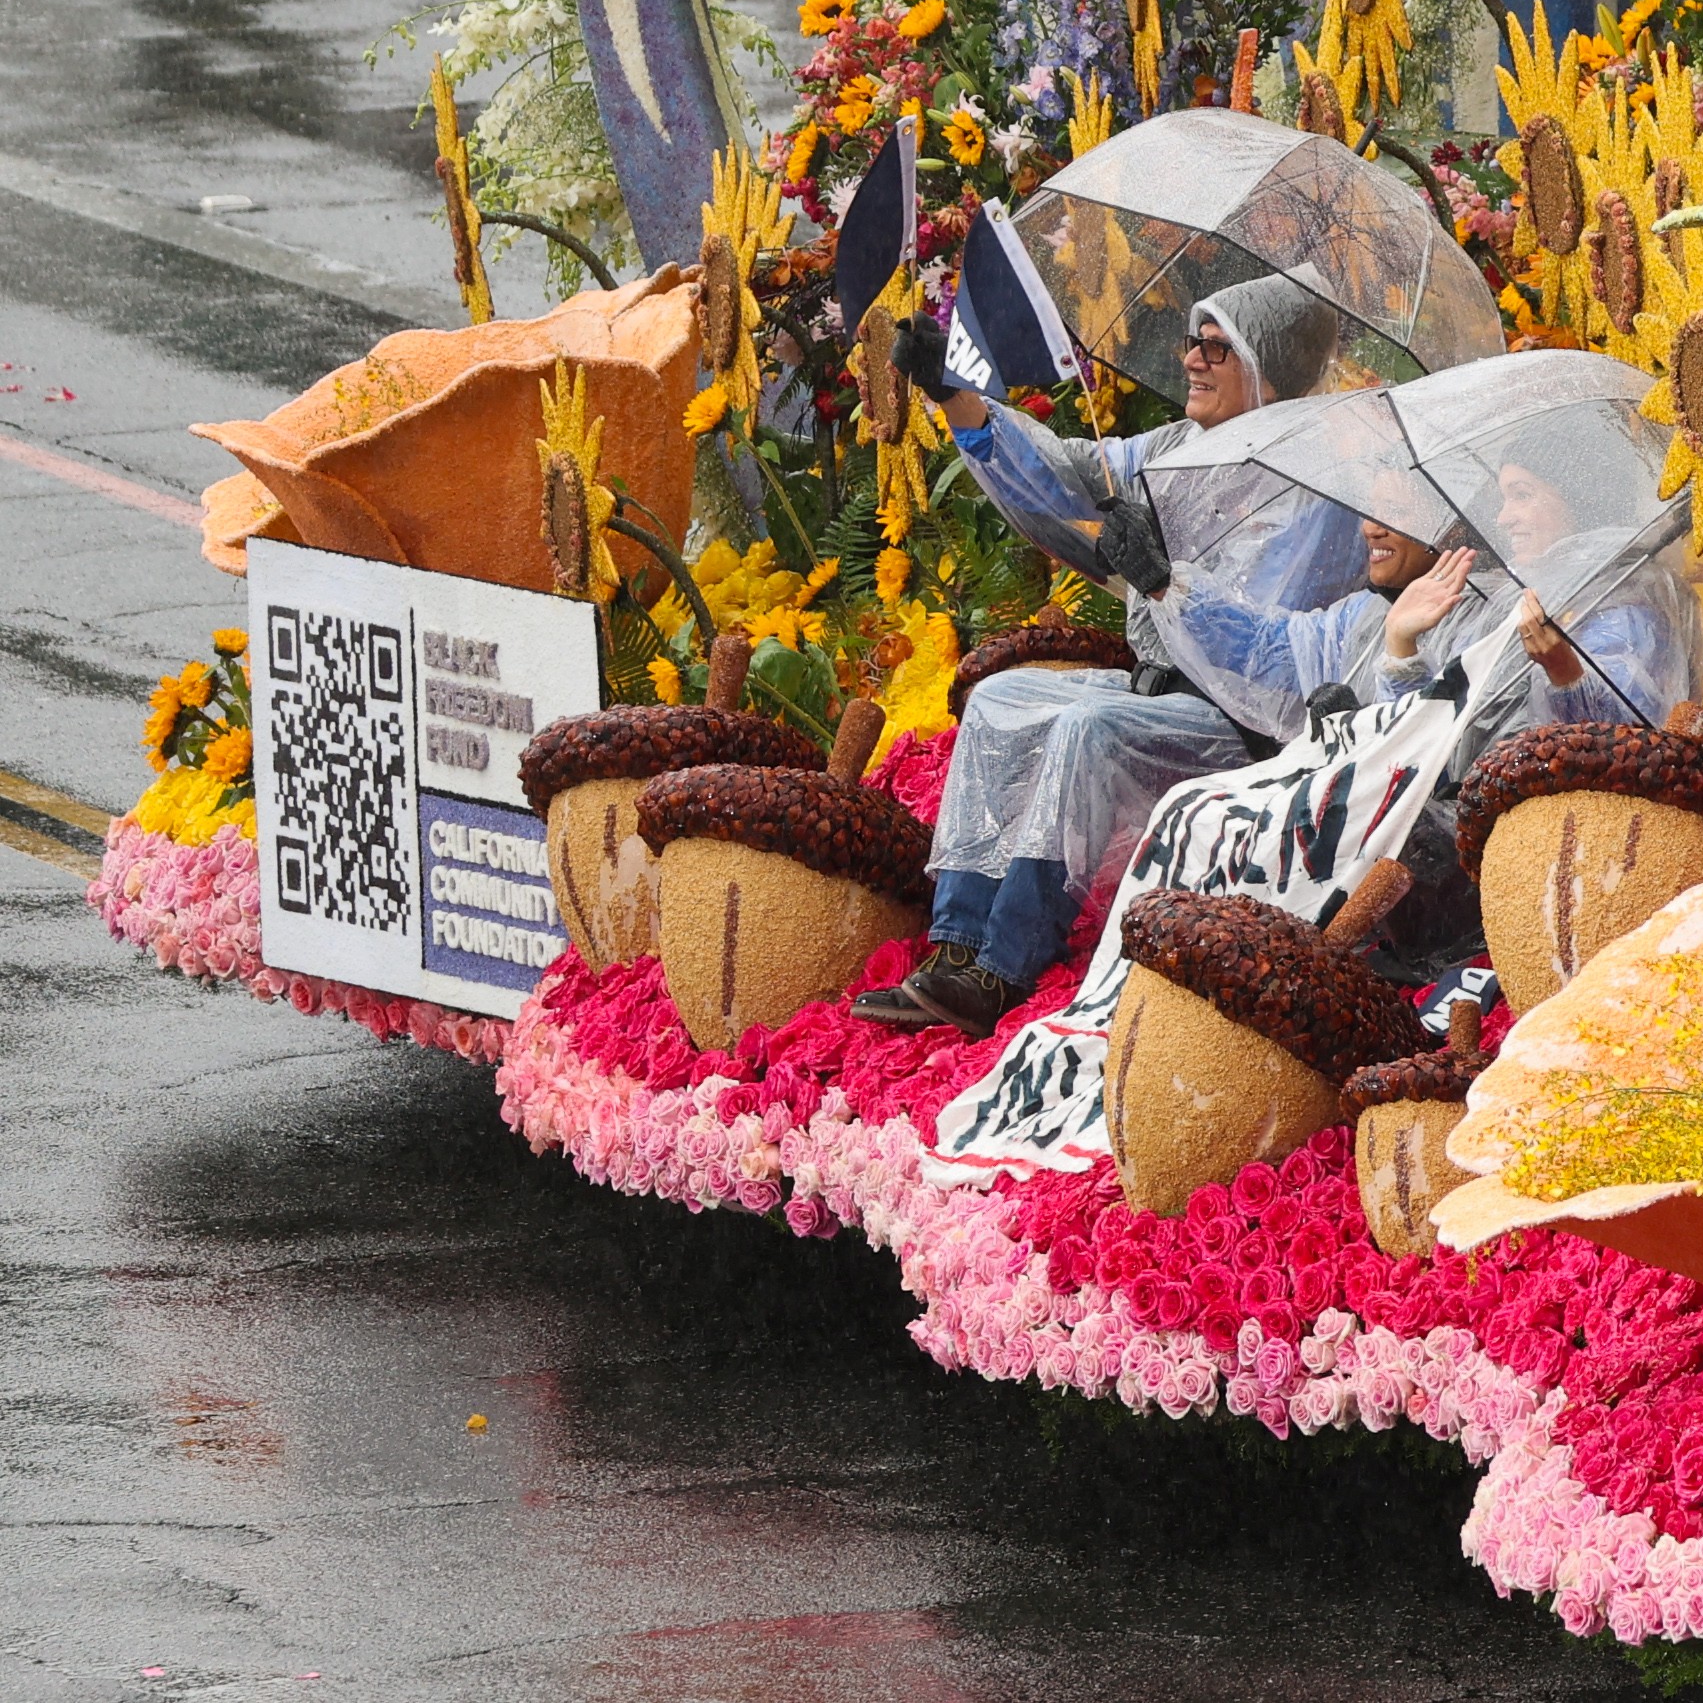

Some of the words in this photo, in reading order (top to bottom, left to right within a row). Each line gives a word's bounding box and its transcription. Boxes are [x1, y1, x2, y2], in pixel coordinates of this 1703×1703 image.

[423, 630, 500, 681] BLACK
[425, 677, 534, 735] FREEDOM
[425, 723, 491, 772] FUND
[428, 820, 550, 880] CALIFORNIA
[430, 865, 559, 927] COMMUNITY
[431, 909, 567, 971] FOUNDATION
